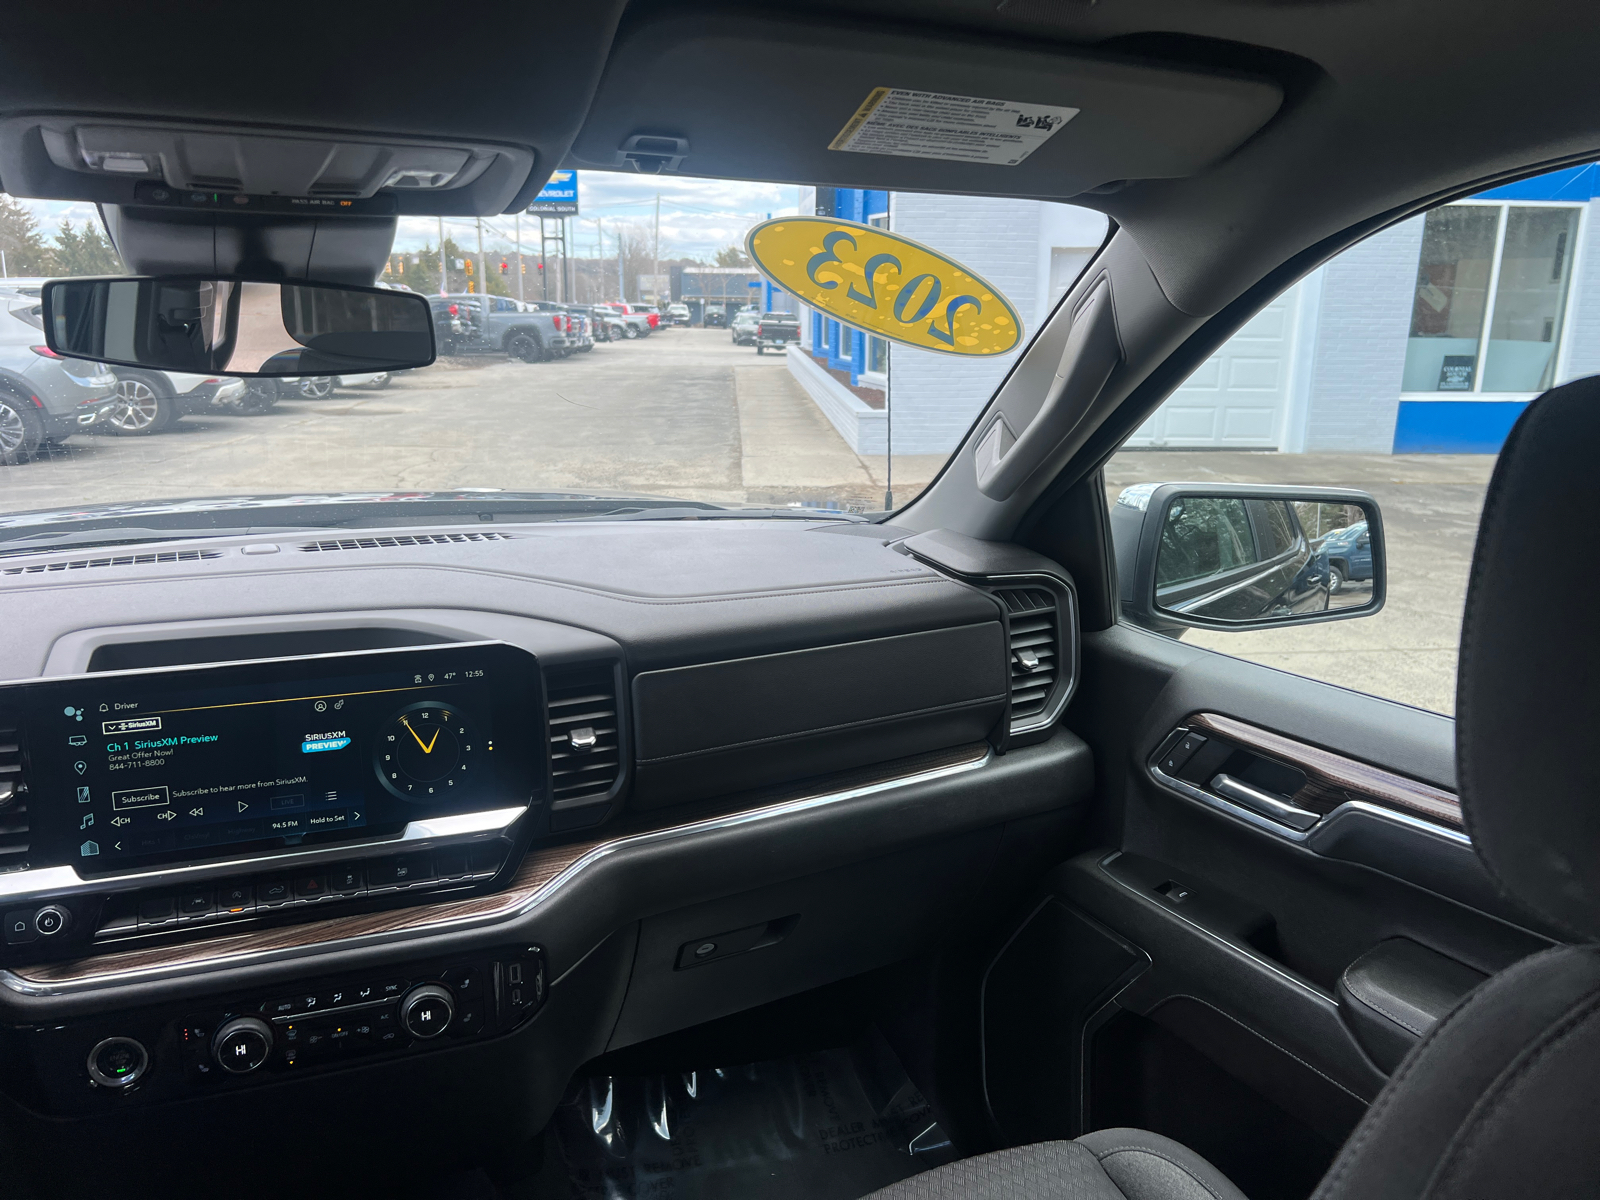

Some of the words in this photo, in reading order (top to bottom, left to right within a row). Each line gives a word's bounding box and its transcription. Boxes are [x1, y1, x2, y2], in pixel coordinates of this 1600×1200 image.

[912, 91, 932, 99] WITH
[931, 93, 971, 103] ADVANCED
[465, 669, 484, 678] 12:55
[114, 701, 138, 710] Driver
[128, 720, 157, 729] SiriusXM
[305, 730, 346, 741] SIRIUSXM
[107, 742, 121, 752] Ch
[134, 737, 178, 750] SiriusXM
[180, 733, 219, 745] Preview
[108, 753, 130, 762] Great
[131, 751, 153, 760] Offer
[154, 748, 174, 757] Now!
[109, 758, 165, 771] 844-711-8800
[172, 787, 209, 798] Subscribe
[210, 786, 218, 794] to
[219, 783, 236, 793] hear
[237, 782, 256, 791] more
[257, 779, 275, 789] from
[275, 775, 308, 786] SiriusXM.
[122, 793, 160, 804] Subscribe
[120, 817, 131, 825] CH
[157, 812, 168, 820] CH
[310, 816, 325, 825] Hold
[334, 814, 345, 822] Set
[272, 821, 287, 830] 94.5
[287, 820, 298, 828] FM
[384, 984, 398, 992] SYNC
[818, 1121, 865, 1140] DEALER
